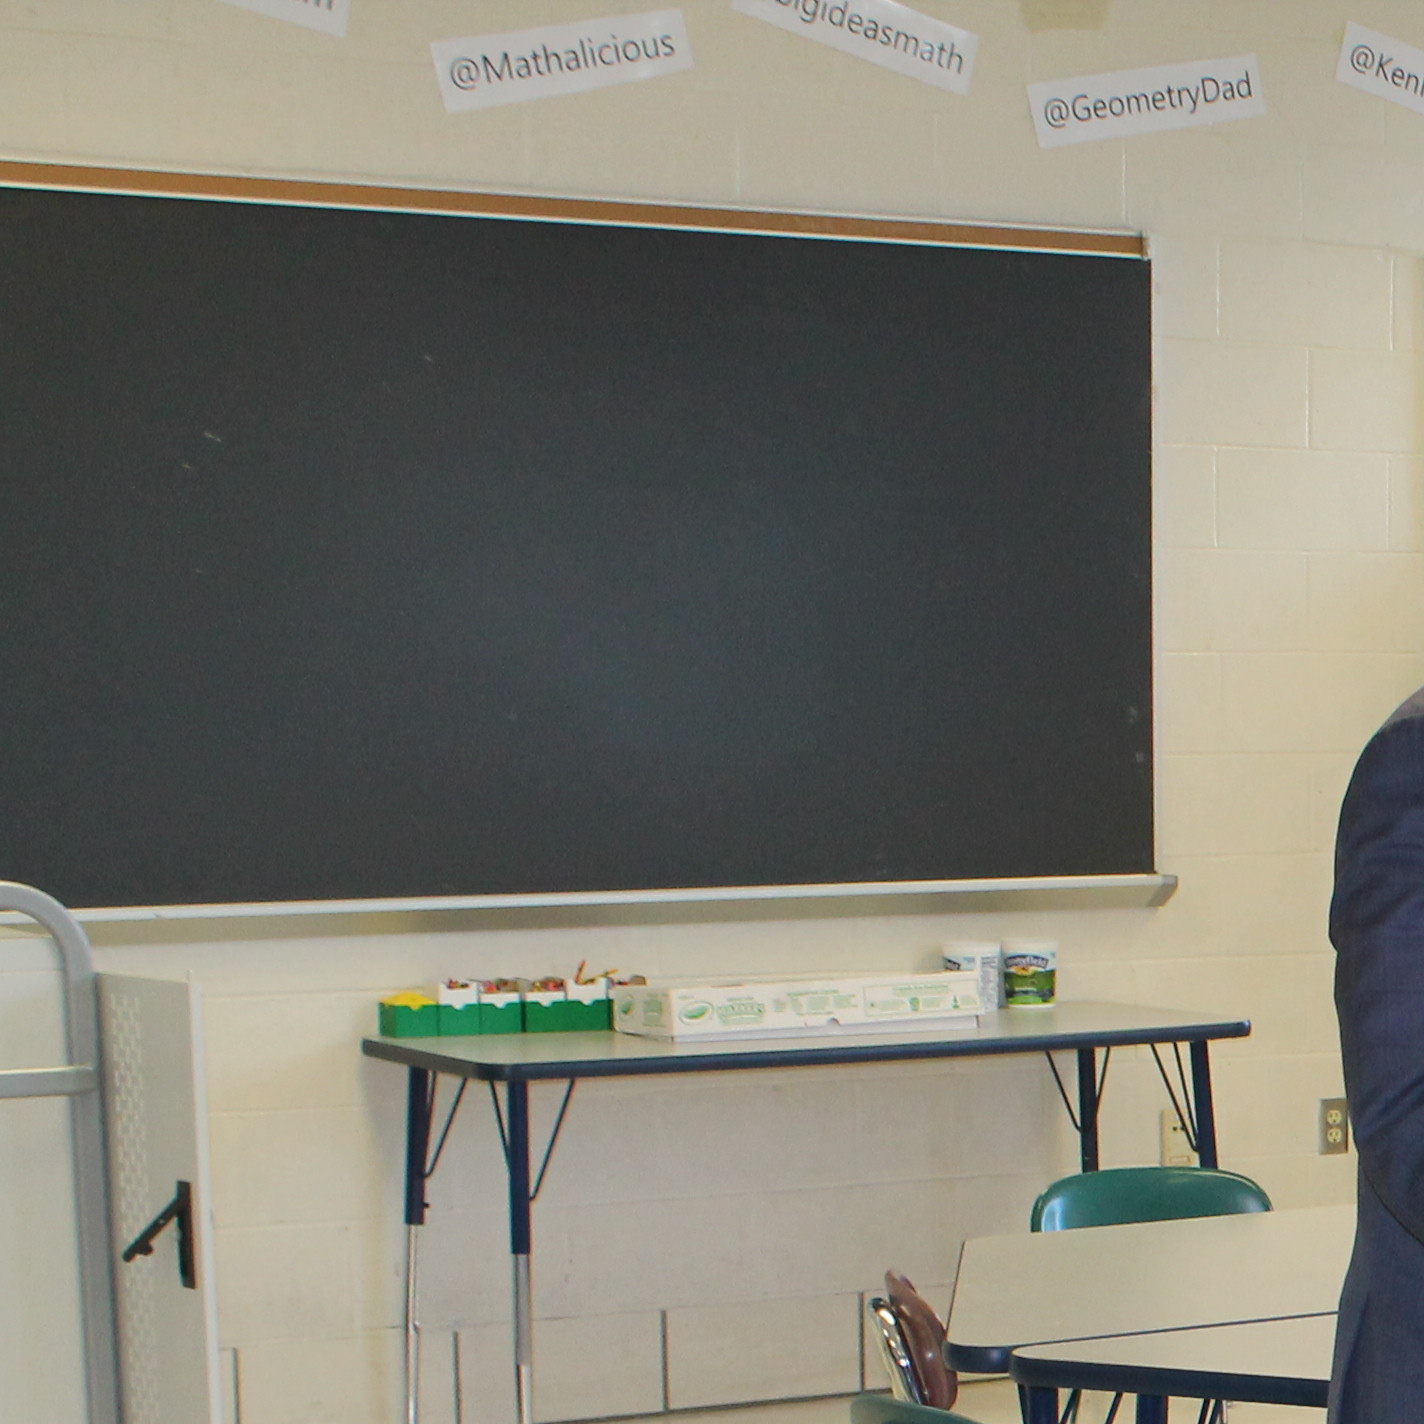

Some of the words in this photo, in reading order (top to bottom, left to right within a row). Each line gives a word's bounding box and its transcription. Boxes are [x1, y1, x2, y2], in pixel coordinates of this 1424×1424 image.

[449, 32, 677, 91] @Mathalicious
[775, 0, 963, 74] gideasmath
[1044, 70, 1253, 128] @GeometryDad
